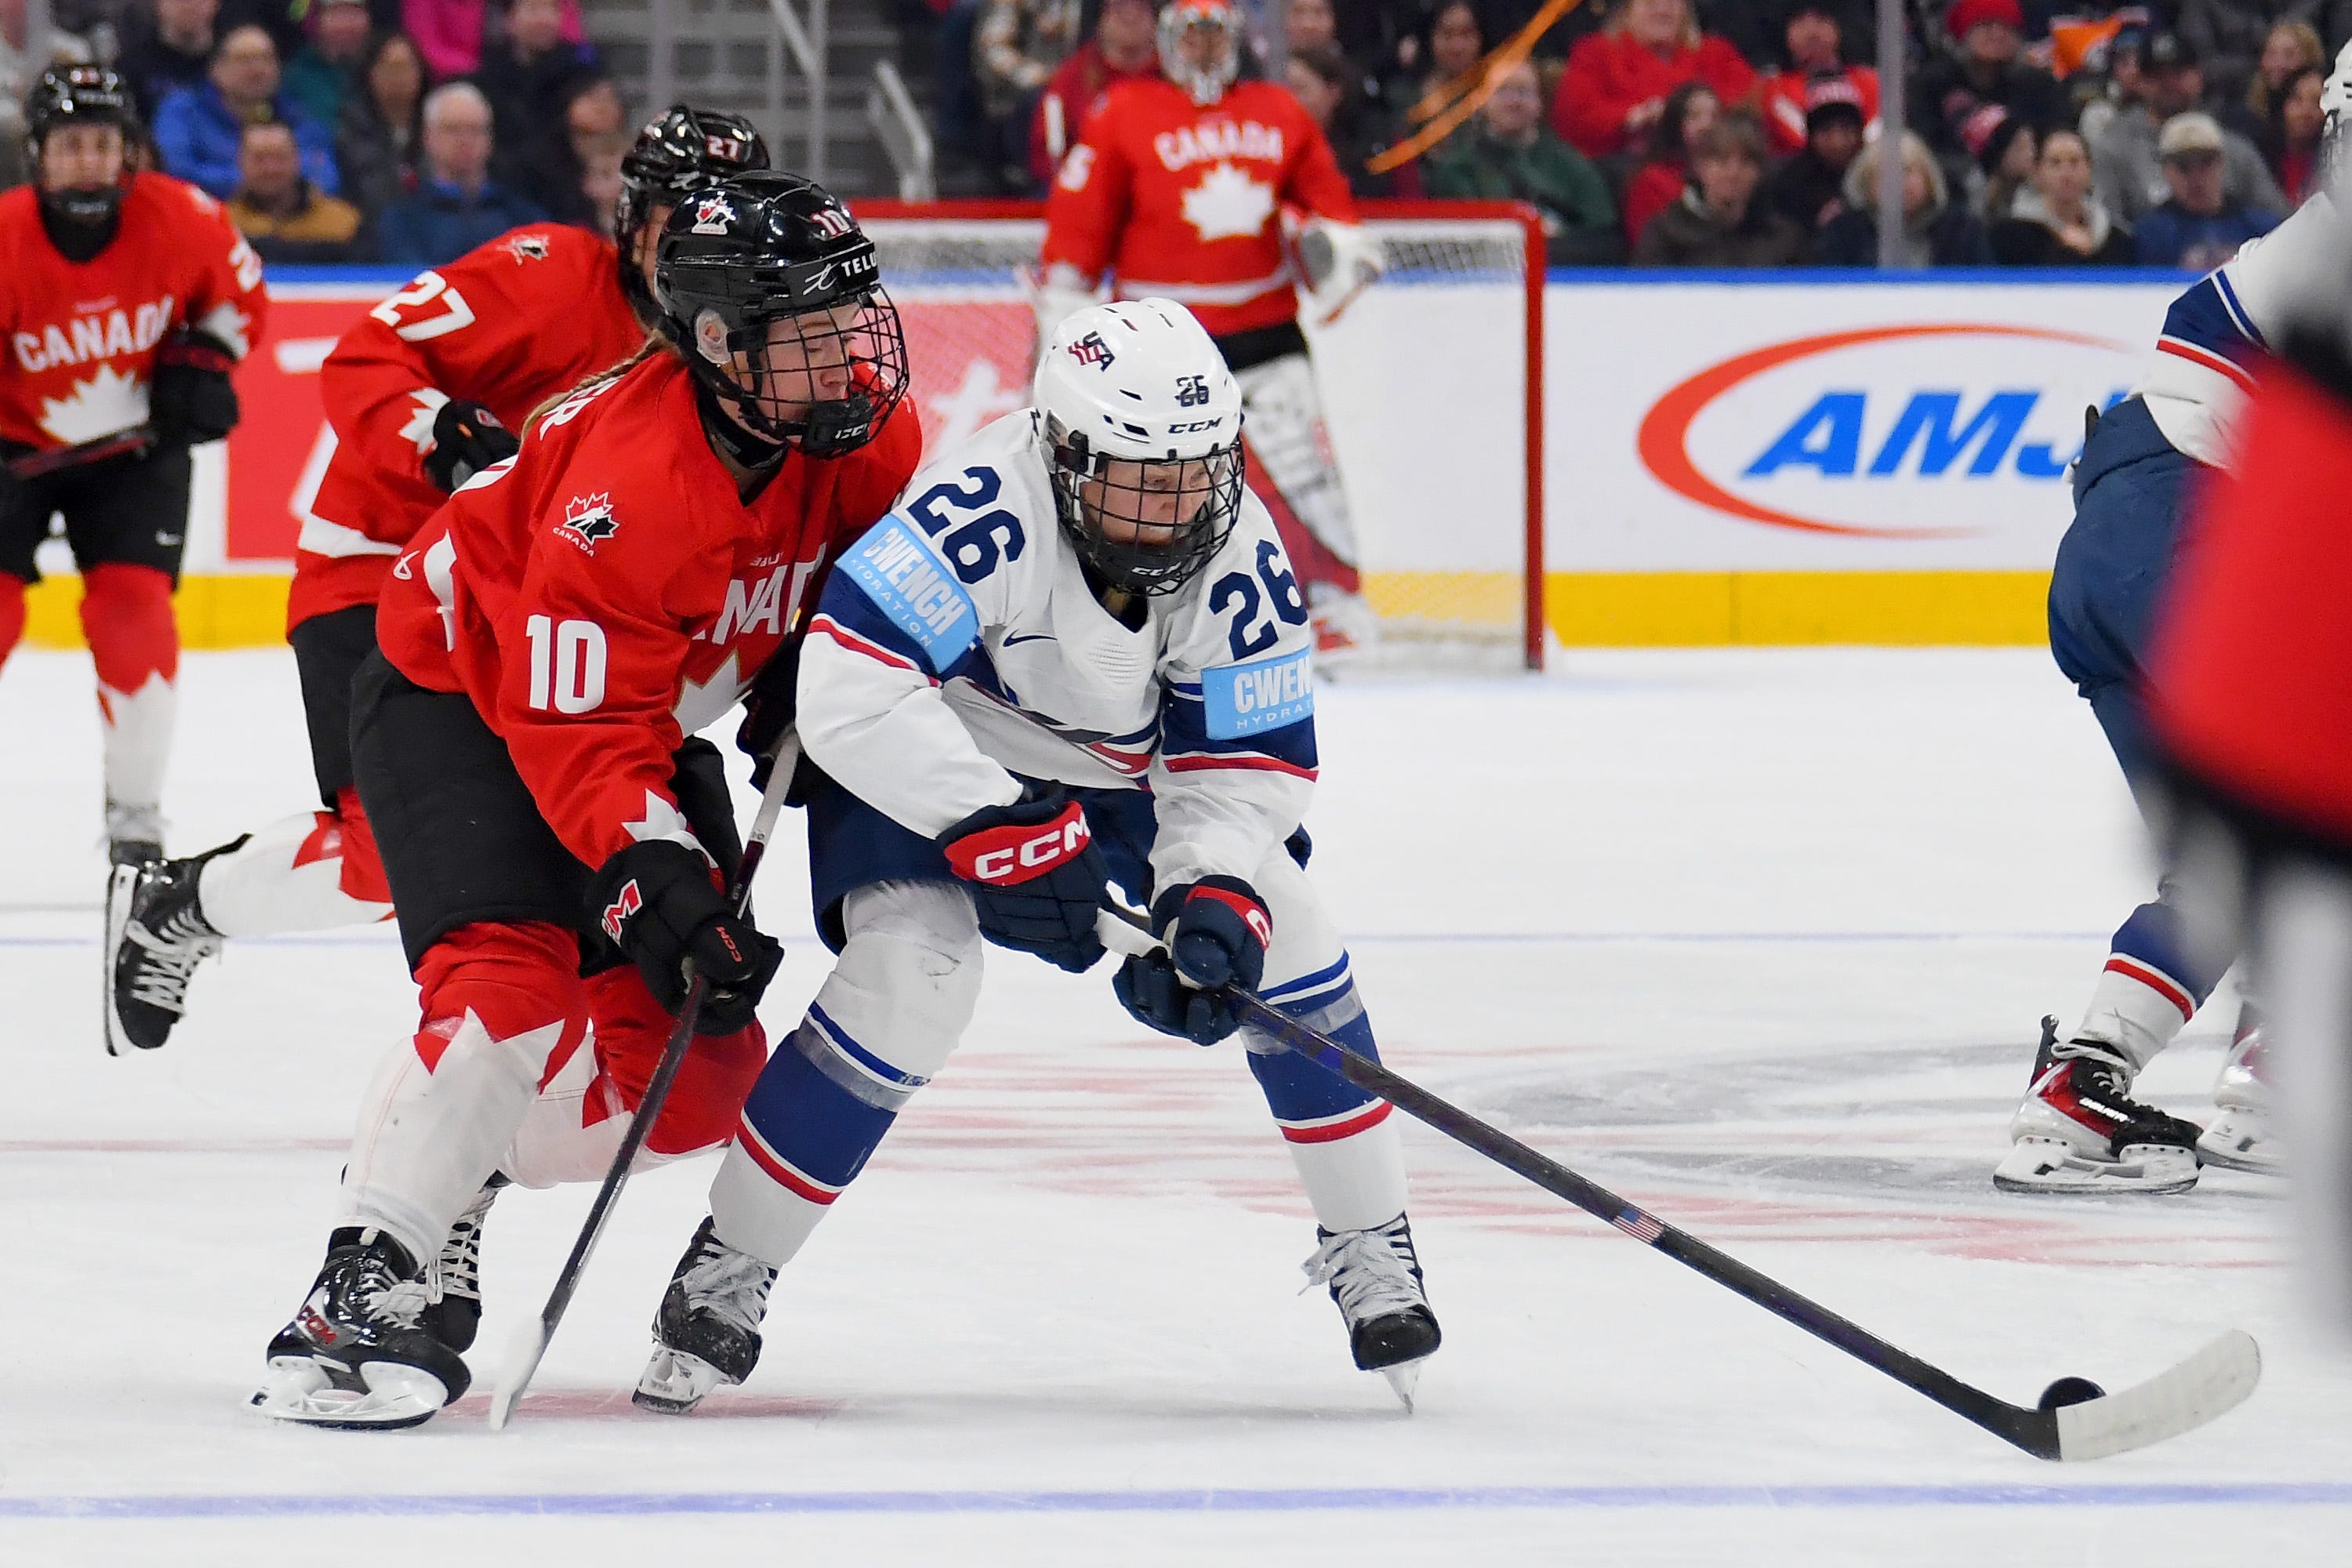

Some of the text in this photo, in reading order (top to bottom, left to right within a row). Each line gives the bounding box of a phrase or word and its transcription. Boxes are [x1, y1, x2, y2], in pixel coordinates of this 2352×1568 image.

[706, 135, 741, 162] 27
[811, 209, 852, 238] 10
[840, 251, 877, 277] TELU
[370, 270, 476, 342] 27
[1167, 416, 1223, 434] CCM
[552, 526, 594, 557] CANADA
[907, 466, 1025, 585] 26
[850, 558, 933, 648] HYDRATION
[863, 527, 967, 637] CWENCH
[1209, 539, 1308, 661] 26
[525, 614, 607, 715] 10
[1233, 654, 1312, 714] CWEN
[1236, 699, 1312, 729] HYDRAT
[975, 811, 1092, 880] CCM
[715, 925, 743, 963] CCM
